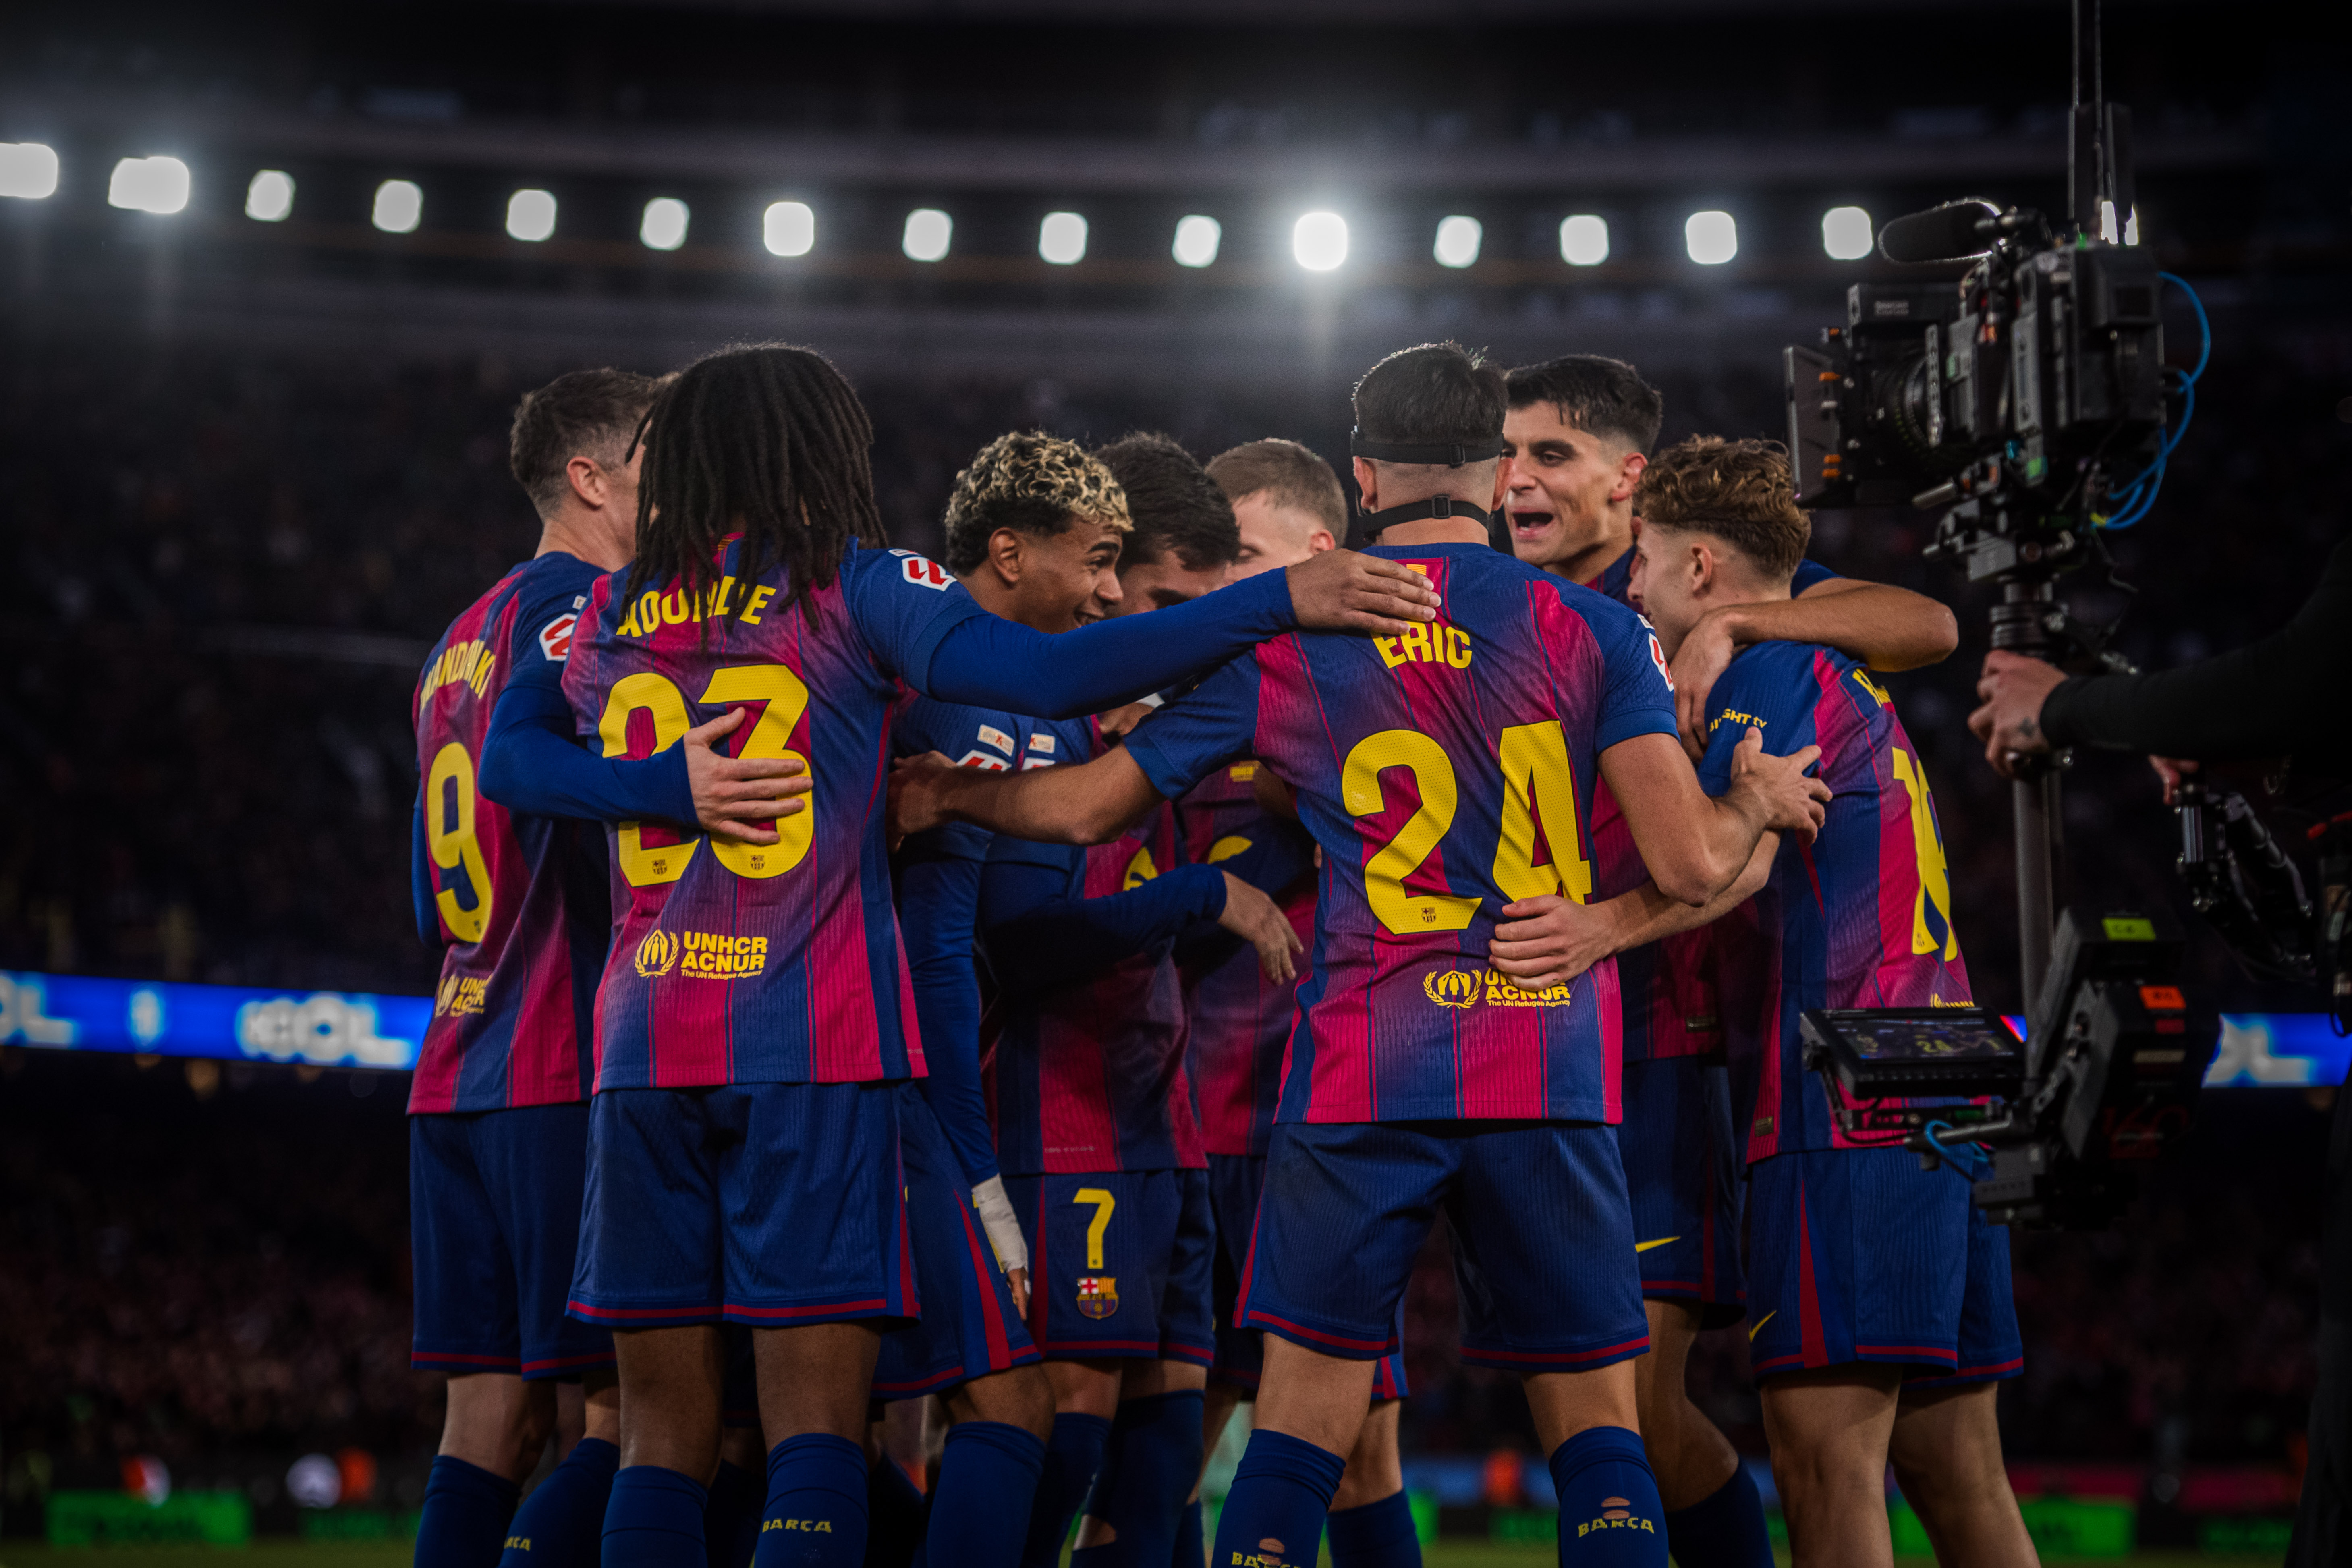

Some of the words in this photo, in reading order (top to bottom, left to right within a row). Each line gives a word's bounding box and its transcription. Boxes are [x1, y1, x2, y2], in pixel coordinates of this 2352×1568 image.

[1372, 620, 1472, 669] ERIC
[599, 664, 814, 887] 23
[427, 742, 493, 942] 9
[1342, 720, 1592, 935] 24
[680, 951, 766, 972] ACNUR
[681, 969, 695, 977] The
[696, 971, 707, 979] UN
[708, 972, 737, 980] Refugee
[737, 970, 762, 979] Agency
[684, 931, 767, 955] UNHCR
[1073, 1188, 1115, 1269] 7
